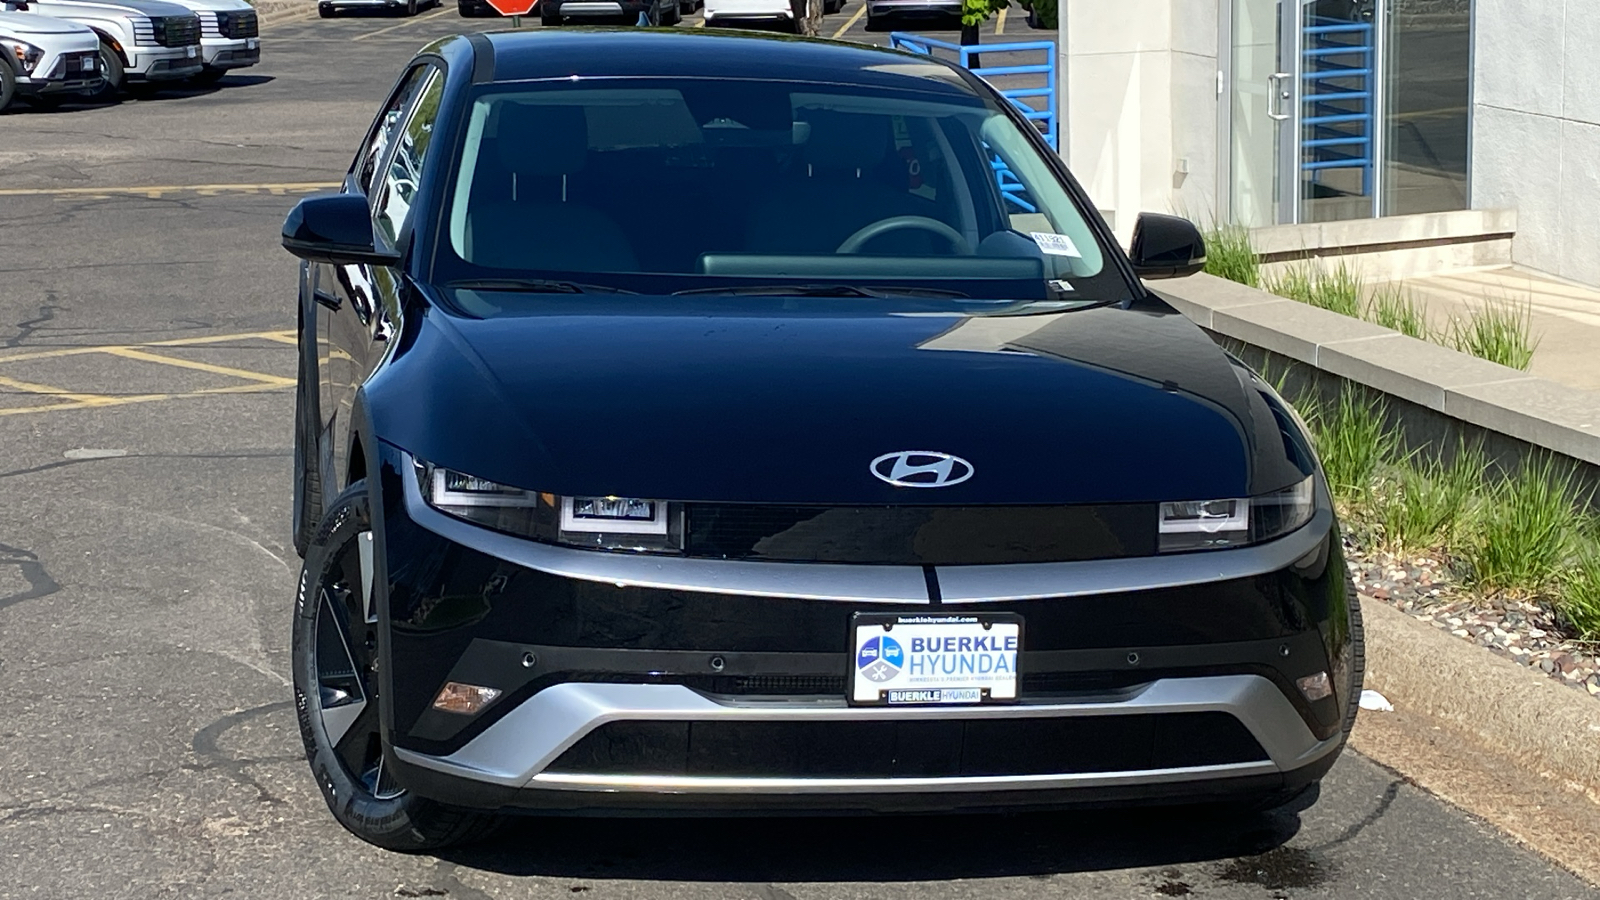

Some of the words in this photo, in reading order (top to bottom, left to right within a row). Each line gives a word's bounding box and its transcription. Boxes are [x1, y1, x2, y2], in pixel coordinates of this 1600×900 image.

[898, 616, 978, 624] buerklehyundai.com
[911, 636, 1017, 652] BUERKLE
[909, 653, 1017, 675] HYUNDAI
[890, 690, 940, 701] BUERKLE
[942, 690, 979, 700] HYUNDAI
